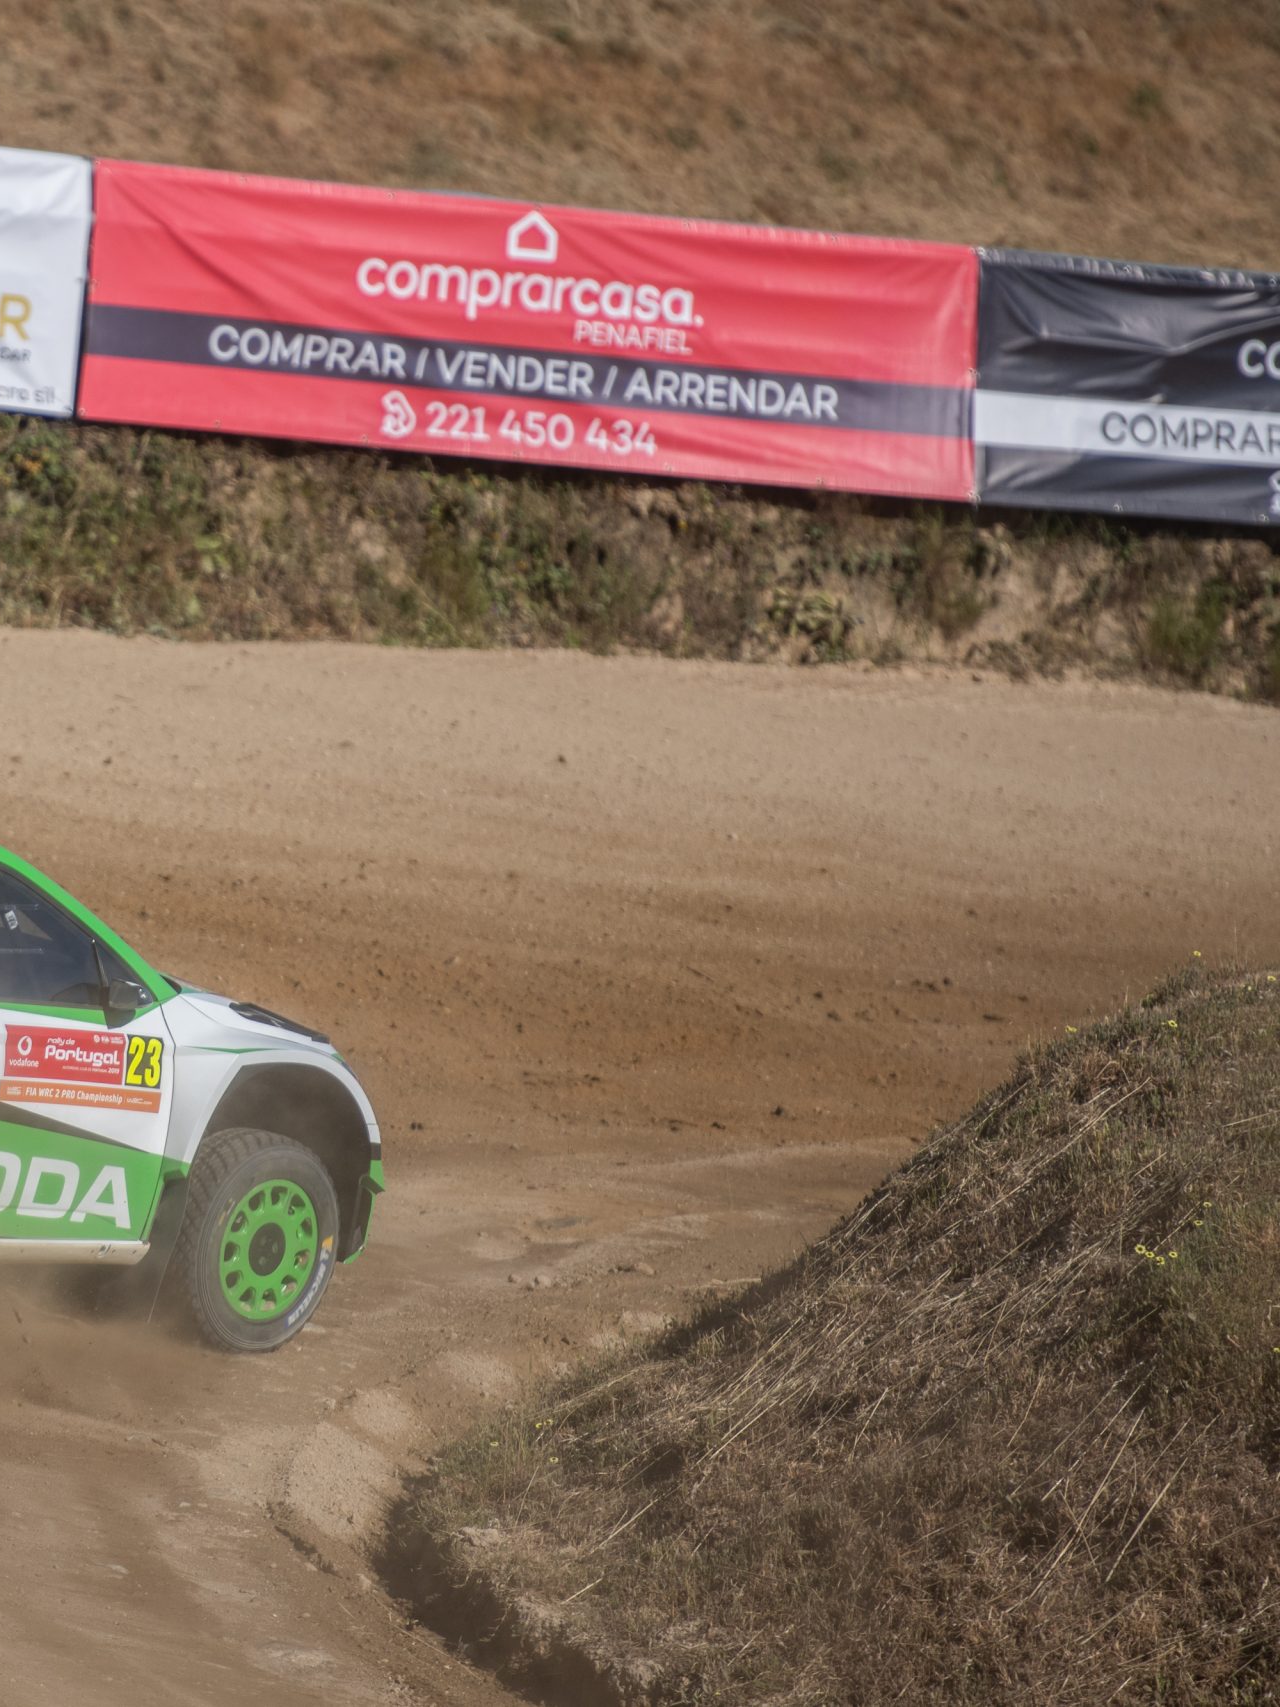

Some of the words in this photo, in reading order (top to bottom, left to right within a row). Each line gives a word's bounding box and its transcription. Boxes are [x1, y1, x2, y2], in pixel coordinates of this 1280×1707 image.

[357, 257, 704, 324] comprarcasa.
[574, 319, 693, 355] PENAFIEL
[208, 323, 407, 380] COMPRAR
[435, 348, 595, 397] VENDER
[623, 367, 839, 421] ARRENDAR
[425, 401, 491, 443] 221
[497, 407, 575, 450] 450
[584, 415, 657, 456] 434
[9, 1057, 40, 1068] vodafone
[45, 1044, 121, 1067] Portugal
[126, 1036, 163, 1088] 23
[25, 1086, 37, 1096] FIA
[38, 1087, 54, 1098] WRC
[61, 1089, 76, 1099] PRO
[76, 1090, 123, 1105] Championship
